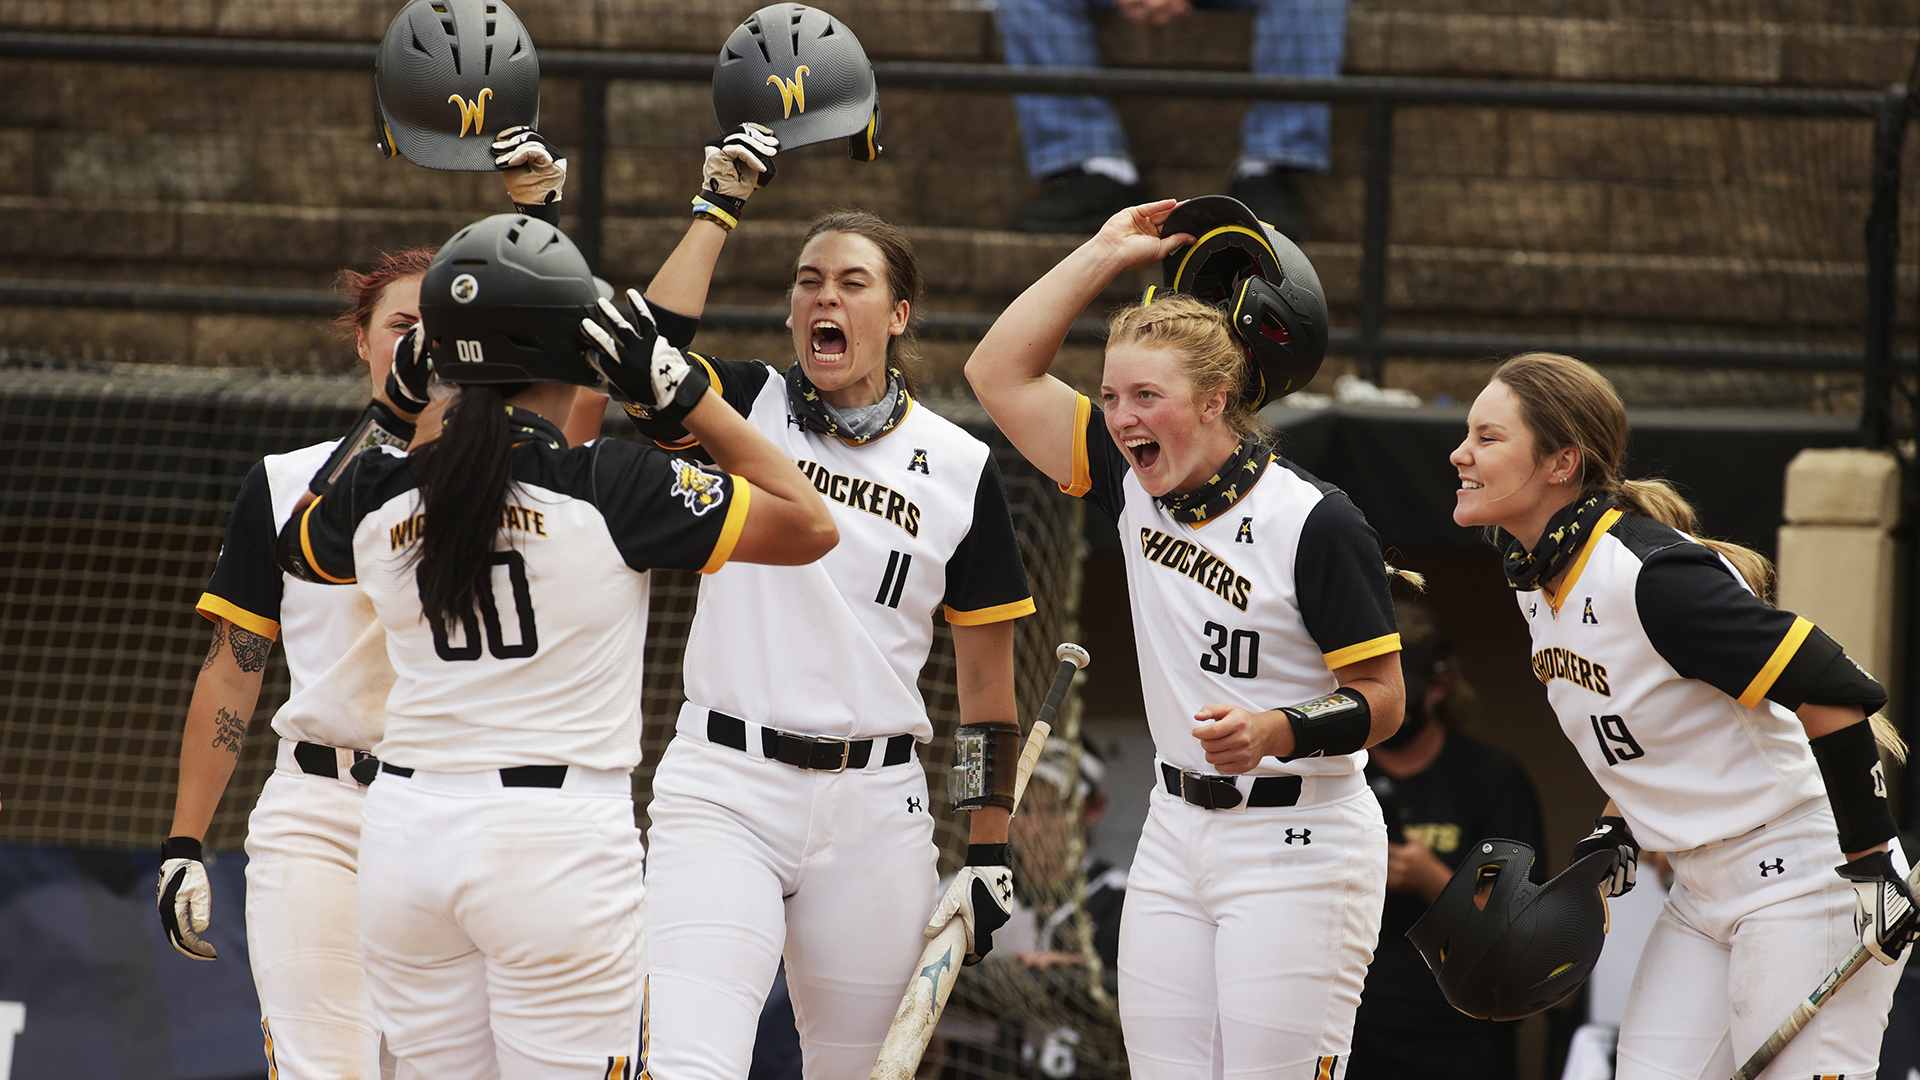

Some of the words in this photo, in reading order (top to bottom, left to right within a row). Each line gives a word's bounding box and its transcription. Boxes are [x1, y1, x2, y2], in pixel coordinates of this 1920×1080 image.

[447, 87, 494, 138] W
[767, 65, 810, 119] W
[456, 339, 484, 363] 00
[790, 459, 921, 539] HOCKERS
[874, 550, 912, 609] 11
[1140, 526, 1252, 613] SHOCKERS
[1199, 620, 1260, 679] 30
[1590, 714, 1645, 767] 19
